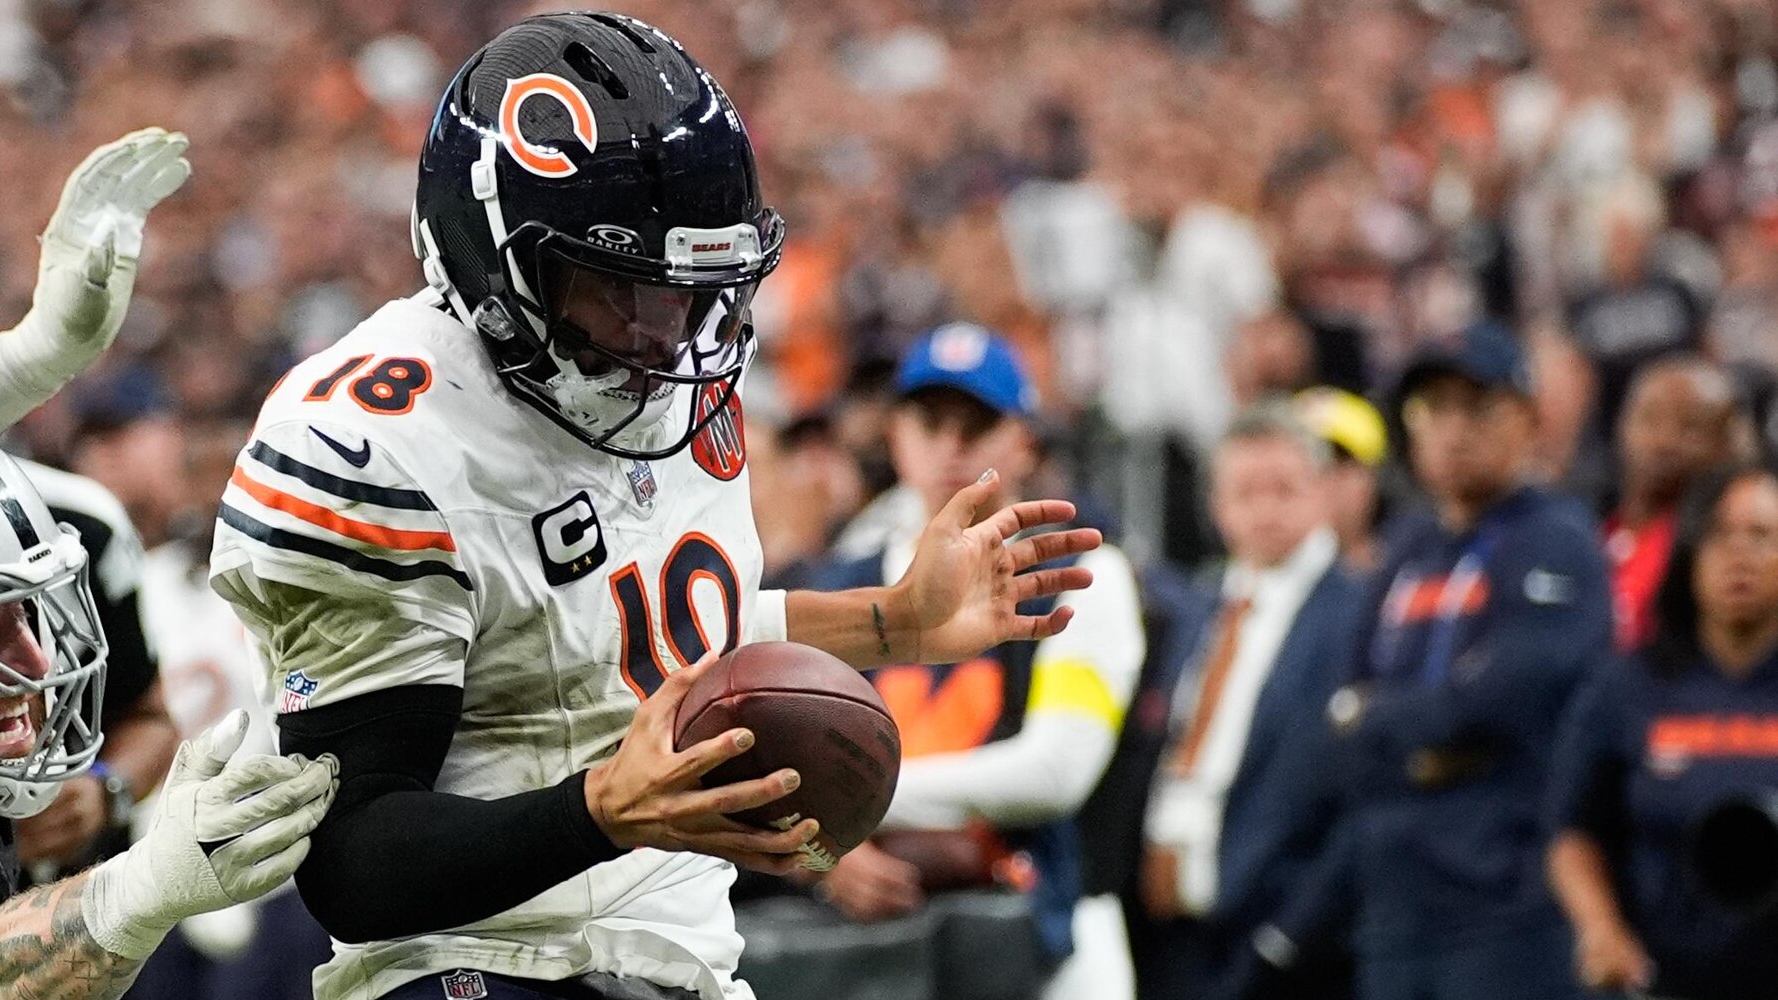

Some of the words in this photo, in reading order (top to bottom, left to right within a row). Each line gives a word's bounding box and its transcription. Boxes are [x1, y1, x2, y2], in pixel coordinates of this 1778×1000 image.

[587, 237, 638, 255] OAKLEY
[692, 242, 731, 253] BEARS
[302, 354, 432, 415] 18
[541, 499, 599, 565] C
[281, 690, 309, 714] NFL
[449, 981, 482, 998] NFL
